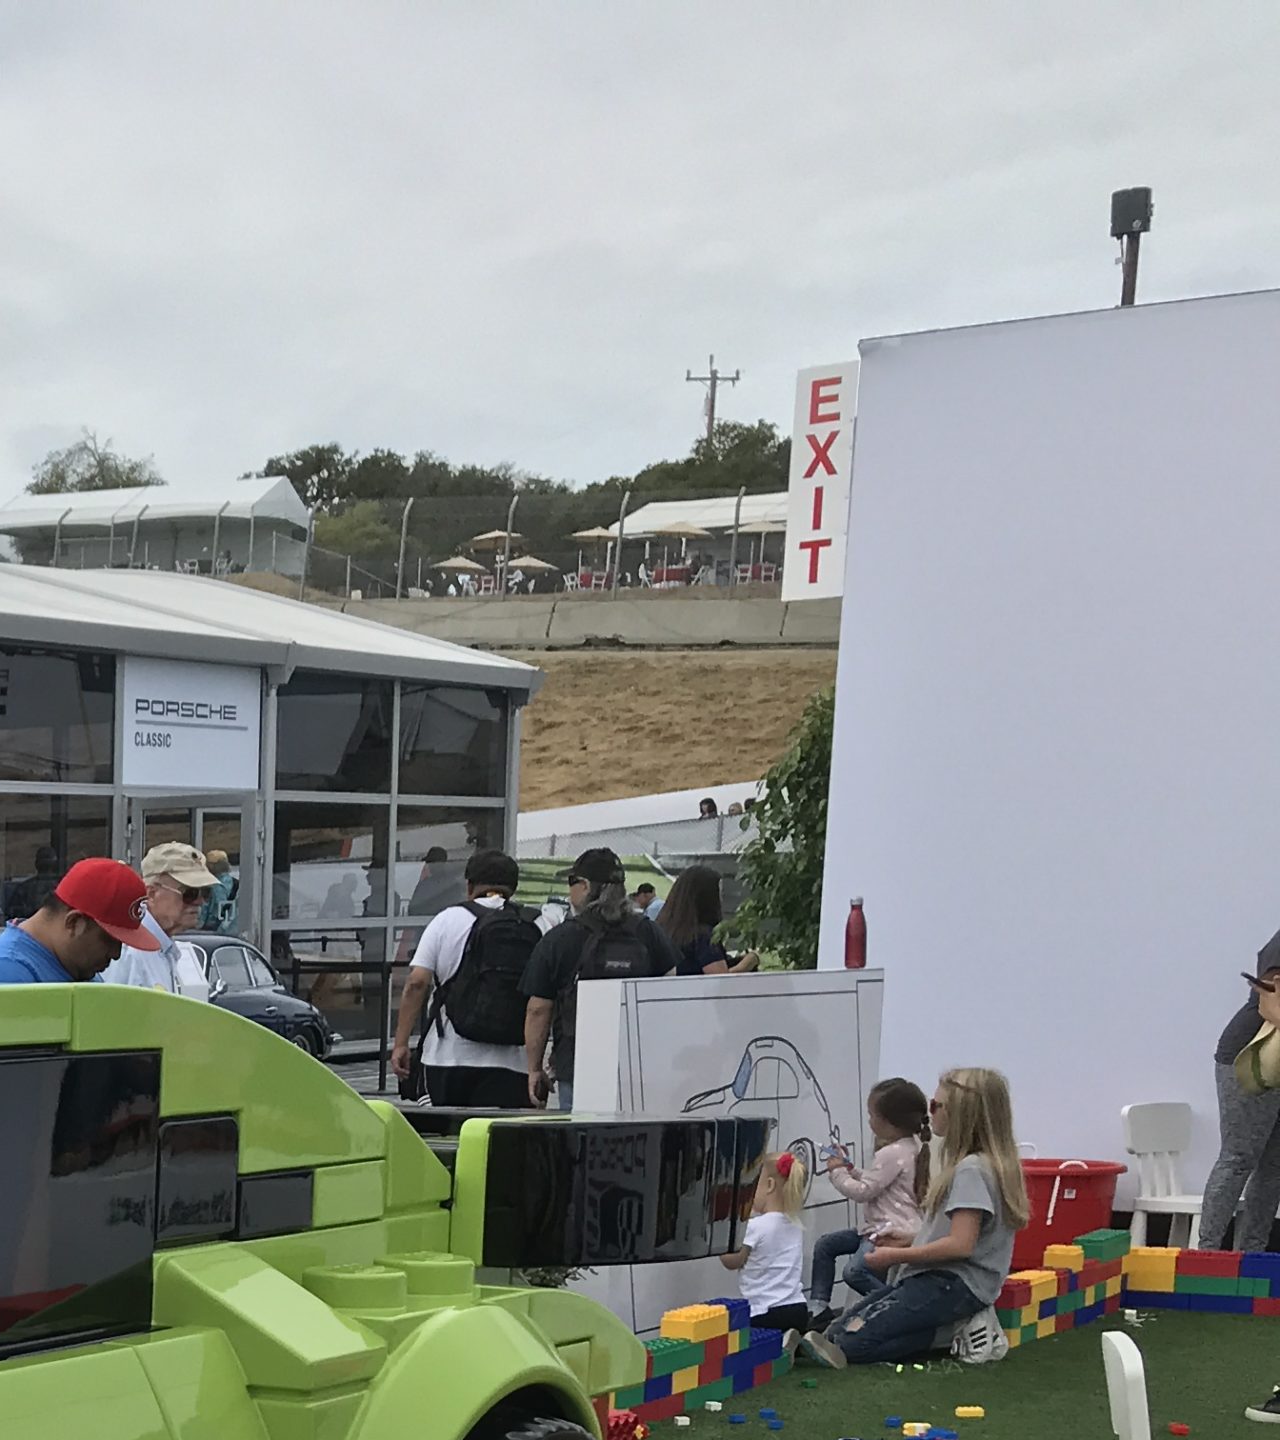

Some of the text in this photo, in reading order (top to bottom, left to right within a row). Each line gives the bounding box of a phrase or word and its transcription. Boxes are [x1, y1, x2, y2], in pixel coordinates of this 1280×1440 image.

[799, 376, 843, 584] EXIT
[135, 698, 237, 721] PORSCHE
[134, 731, 172, 748] CLASSIC
